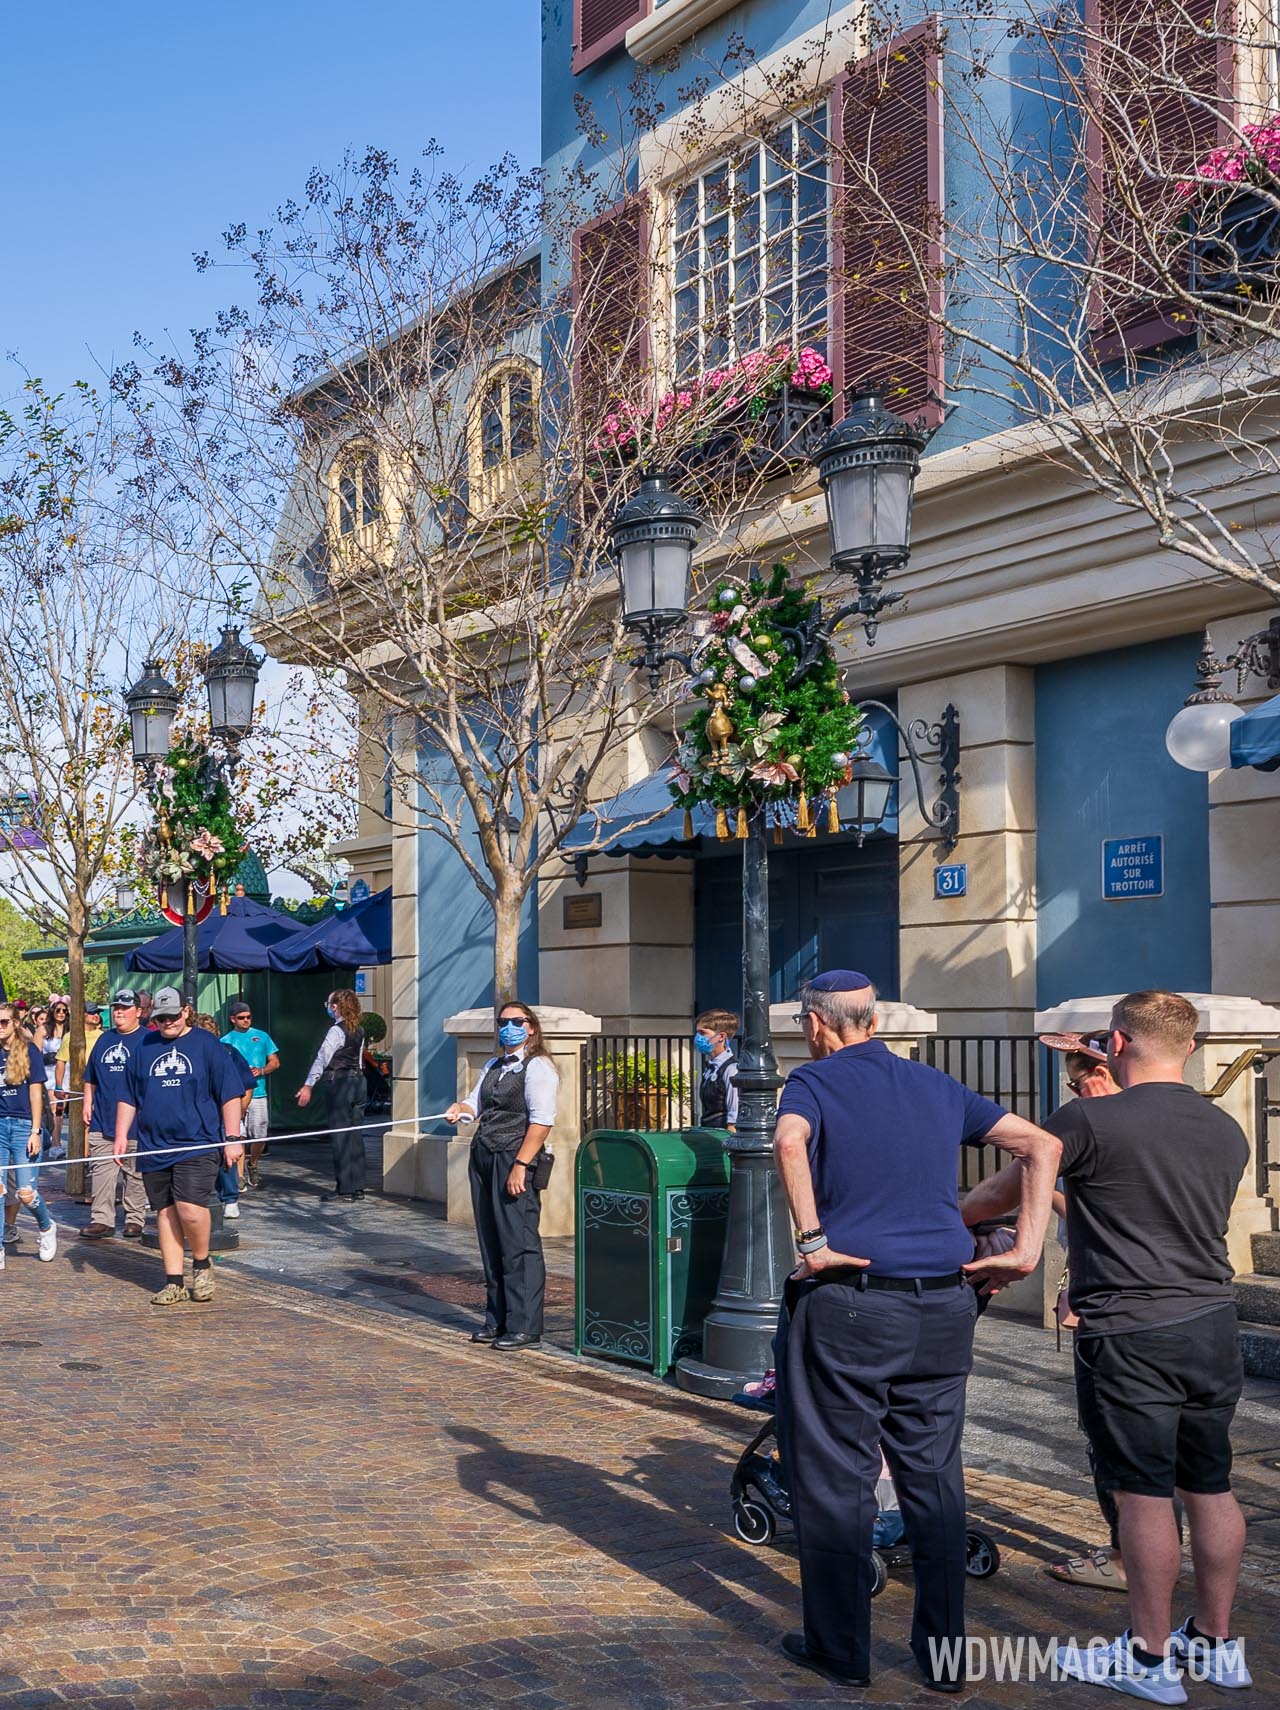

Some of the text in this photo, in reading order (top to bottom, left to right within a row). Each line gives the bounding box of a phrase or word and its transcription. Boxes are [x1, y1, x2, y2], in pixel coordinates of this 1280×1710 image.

[1118, 841, 1146, 855] ARRÊT
[1110, 852, 1155, 868] AUTORISÉ
[1123, 868, 1142, 879] SUR
[942, 871, 959, 890] 31
[1110, 879, 1155, 892] TROTTOIR
[161, 1078, 181, 1088] 2022
